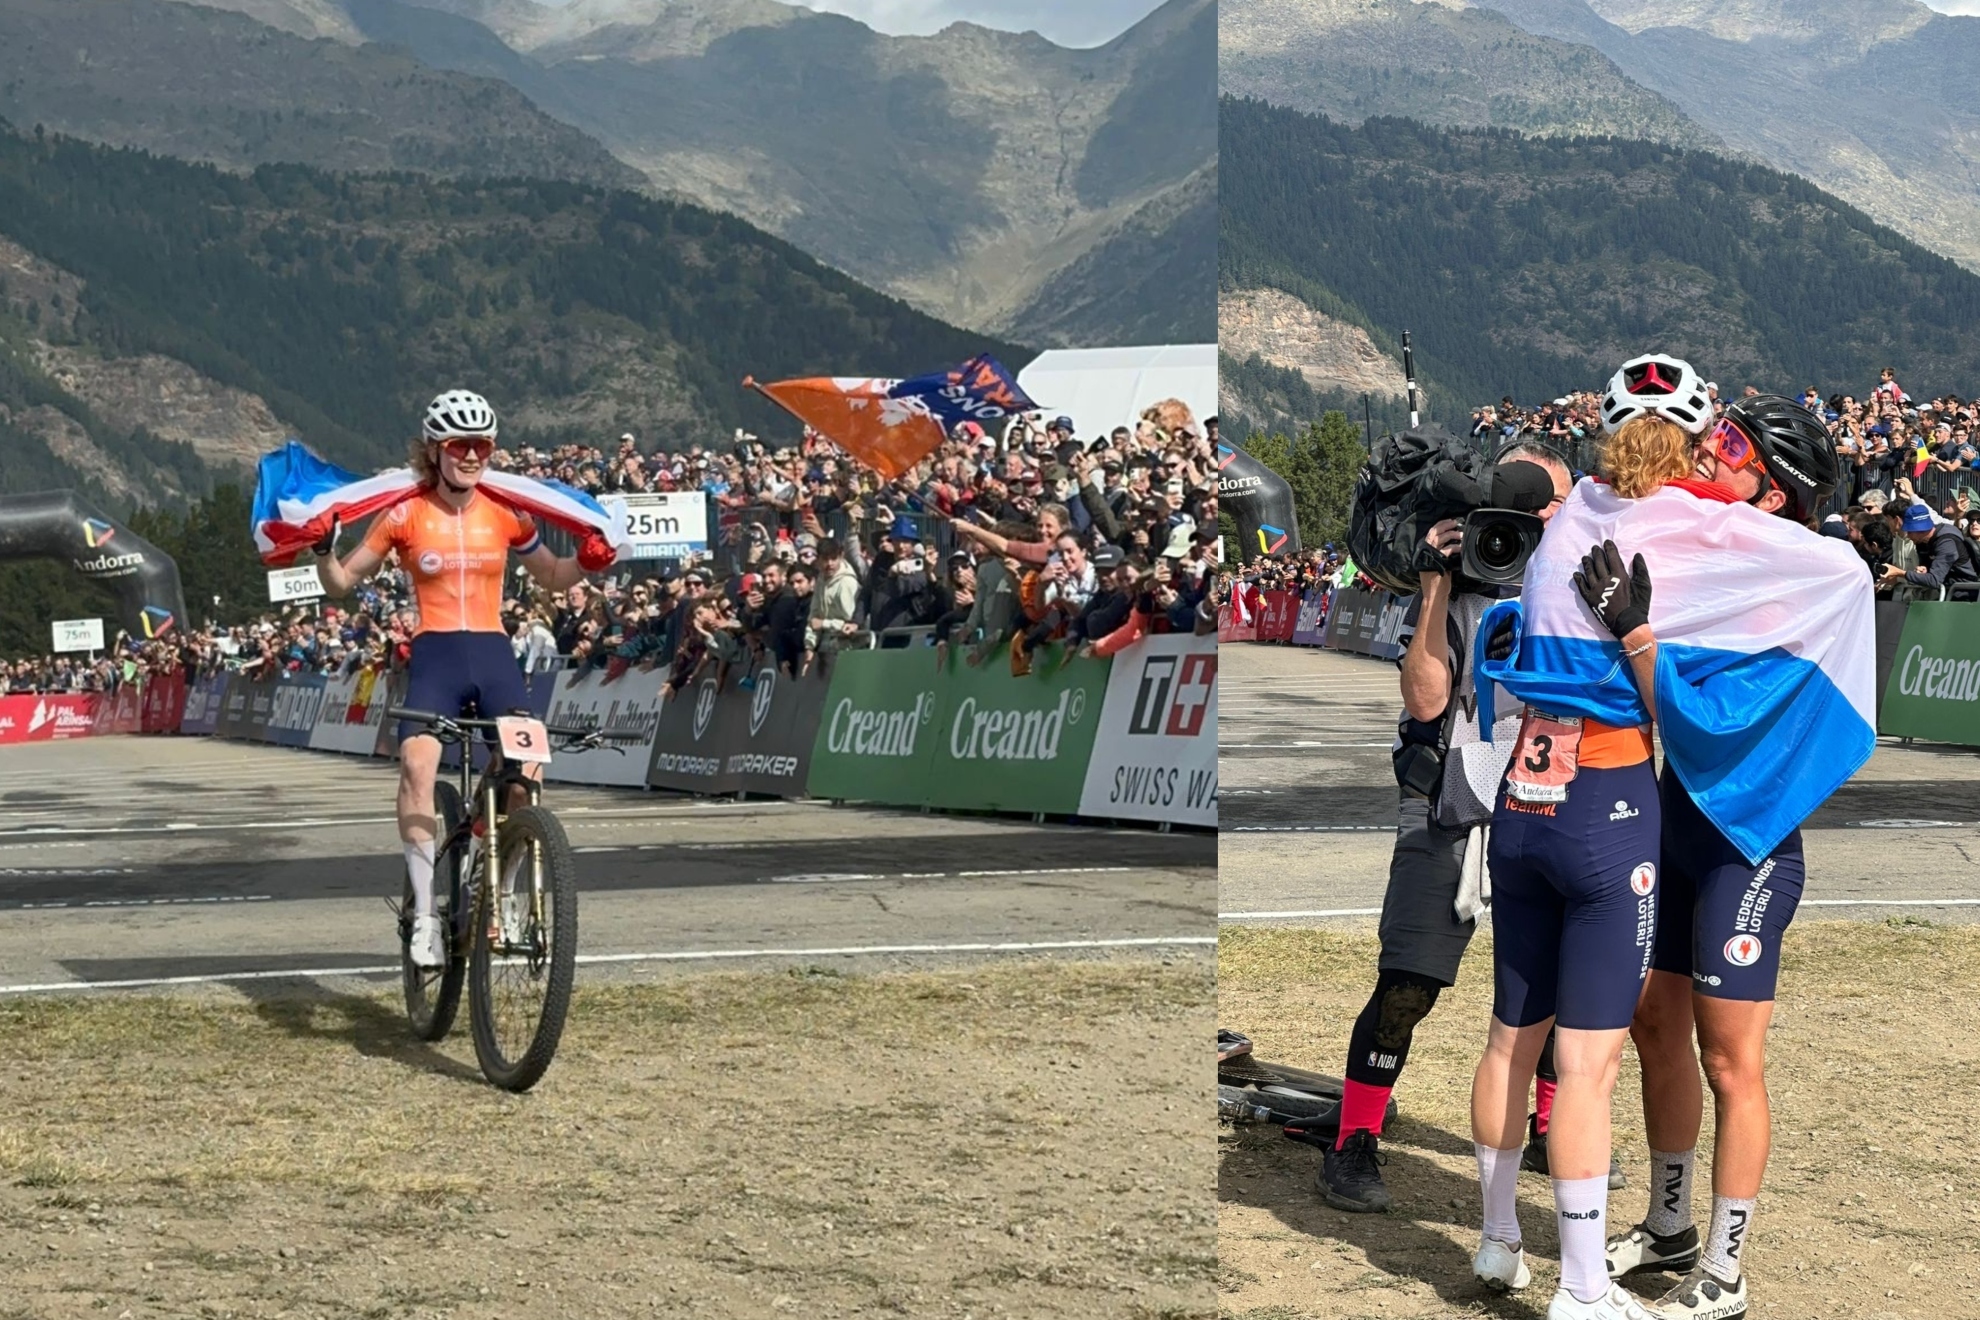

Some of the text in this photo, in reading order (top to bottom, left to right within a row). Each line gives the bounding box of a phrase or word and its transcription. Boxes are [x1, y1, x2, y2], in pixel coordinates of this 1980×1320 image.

[1772, 455, 1817, 487] CRATONI
[626, 514, 679, 535] 25m
[632, 543, 690, 558] IMANO
[73, 552, 145, 571] Andorra
[284, 580, 318, 594] 50m
[64, 631, 91, 640] 75m
[515, 730, 533, 748] 3
[1525, 734, 1553, 773] 3
[726, 753, 798, 777] DRAKER
[1110, 765, 1178, 807] SWISS
[1519, 785, 1553, 796] Andorra
[1609, 808, 1639, 822] AGU
[1735, 857, 1777, 932] NEDERLANDSE
[1749, 888, 1773, 933] LOTERIJ
[1636, 898, 1647, 947] LOTERIJ
[1639, 893, 1655, 980] NEDERLANDSE
[1377, 1053, 1398, 1070] NBA
[1562, 1211, 1588, 1220] AGU
